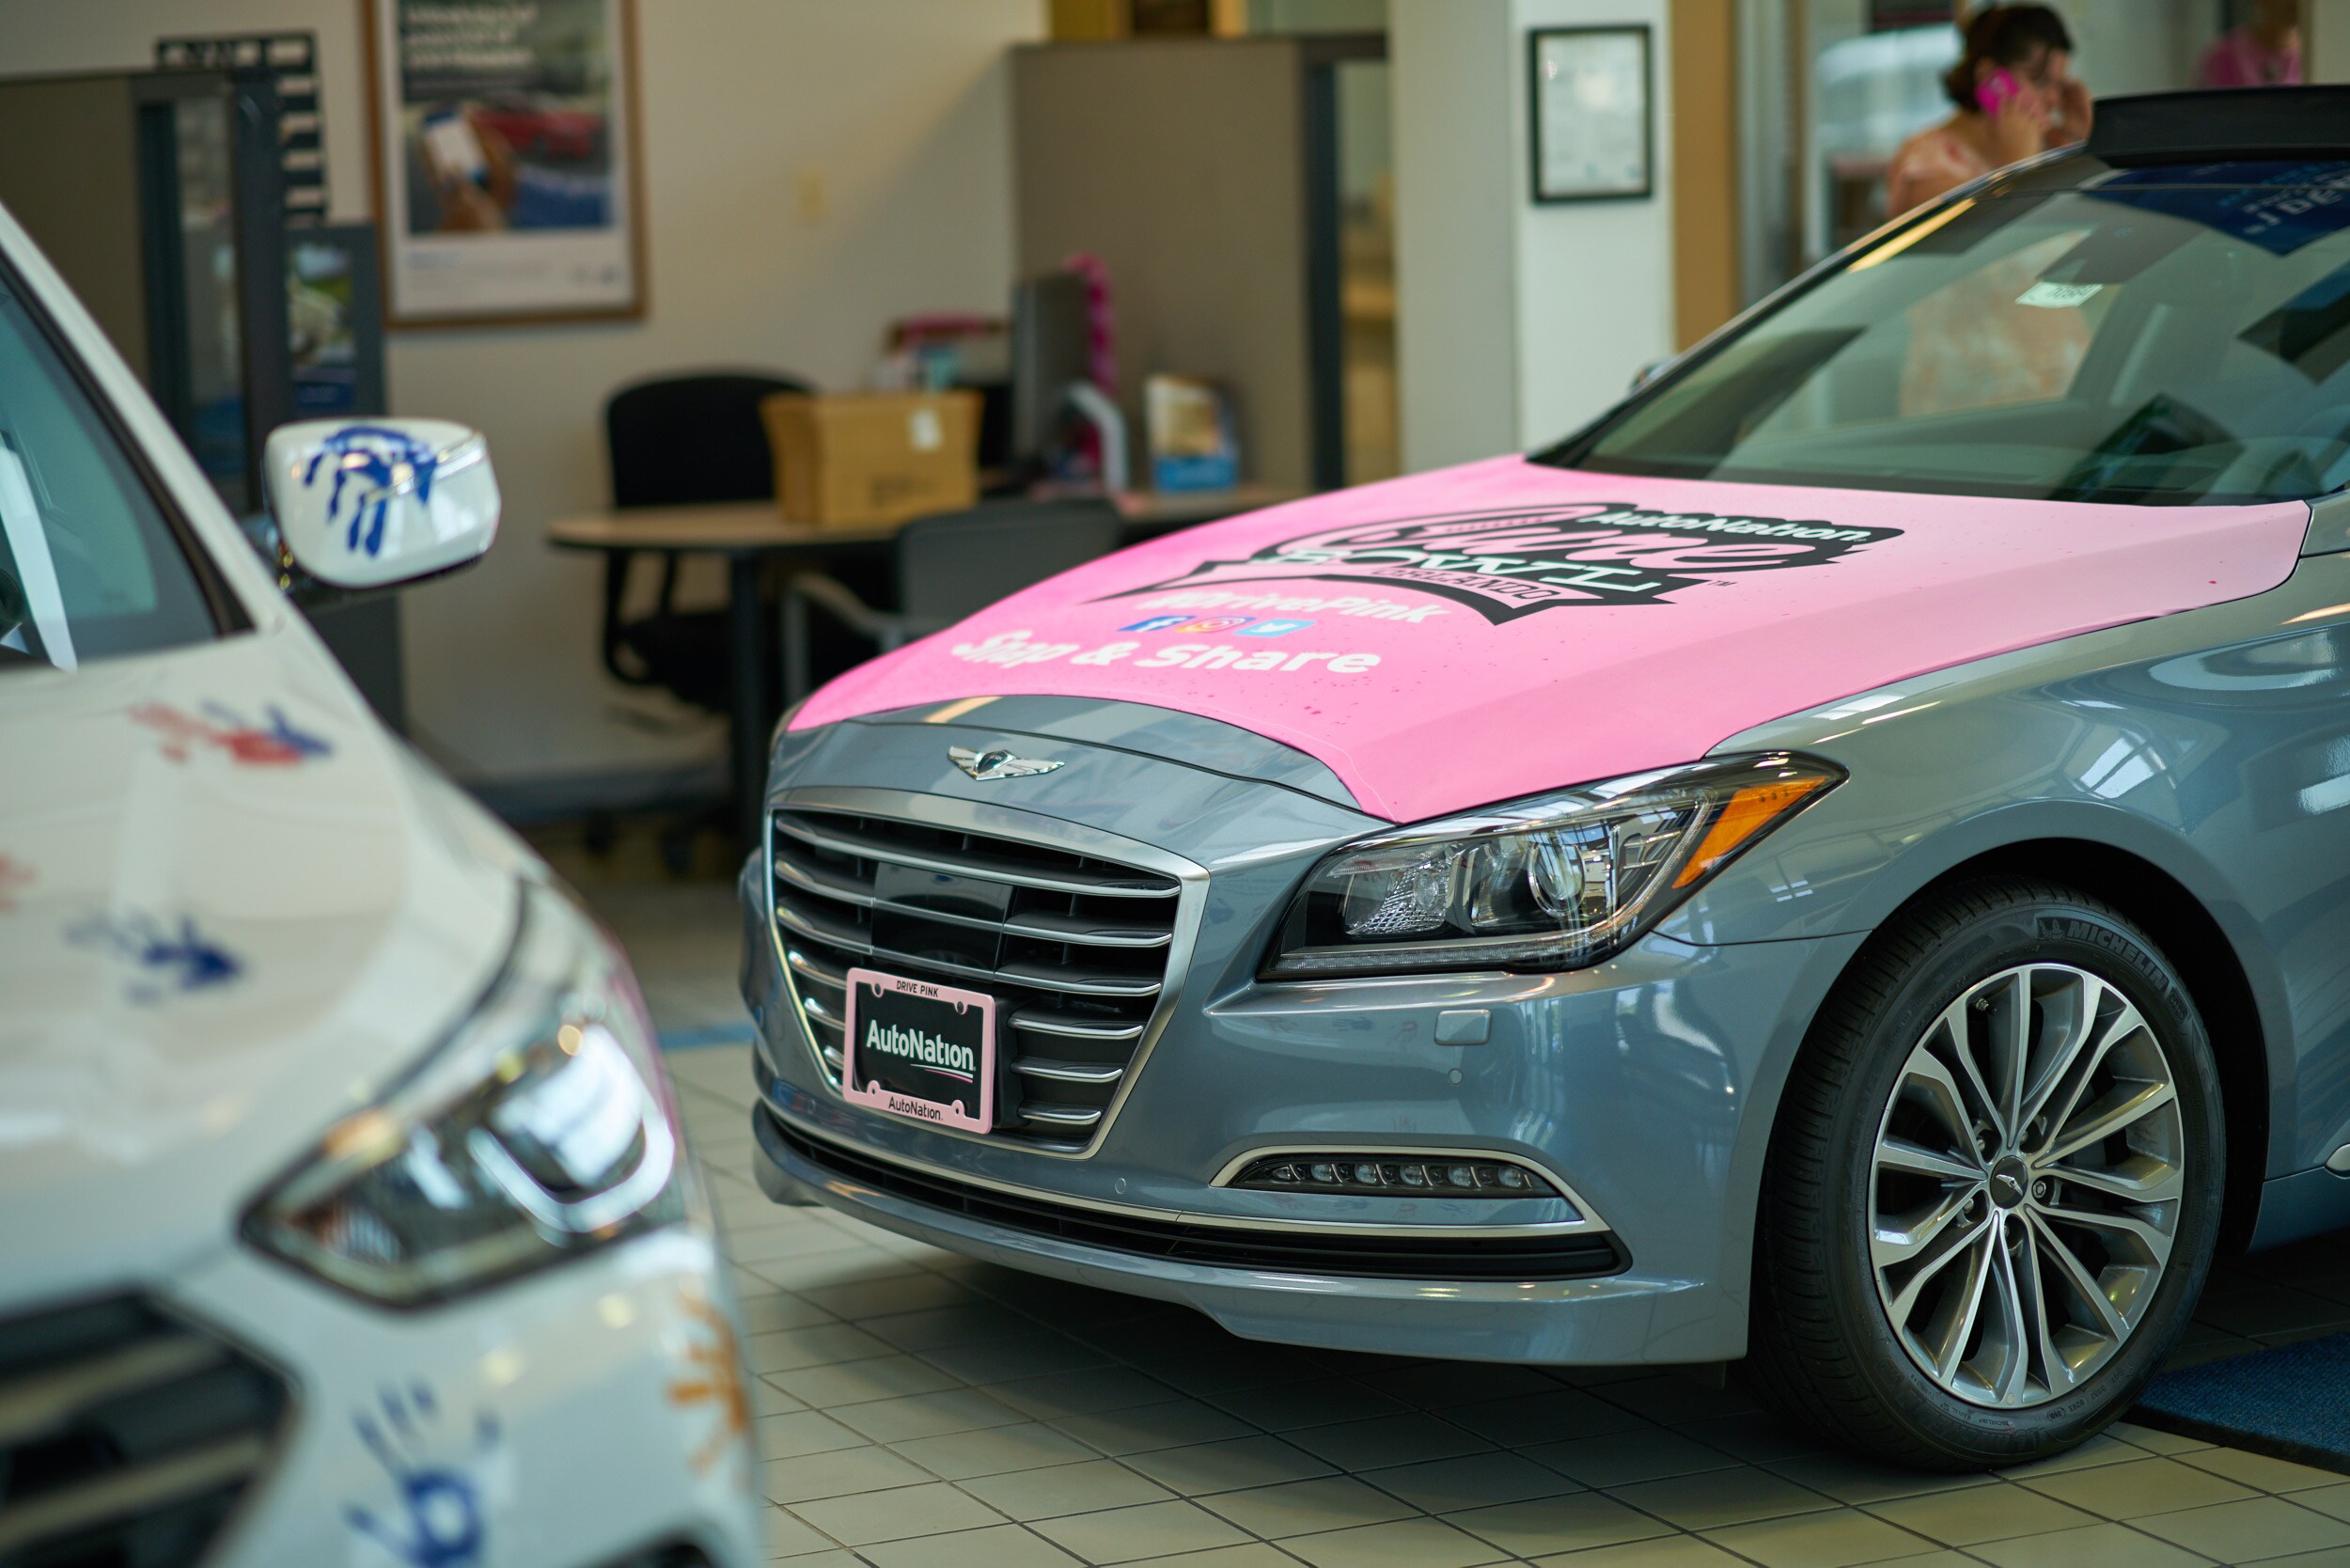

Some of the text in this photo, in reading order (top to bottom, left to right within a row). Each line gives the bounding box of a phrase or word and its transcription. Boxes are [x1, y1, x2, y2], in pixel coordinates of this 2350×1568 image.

[1277, 505, 1819, 570] Cure
[1576, 510, 1871, 541] AutoNation
[1246, 548, 1663, 592] BOWL
[1370, 568, 1562, 600] ORLANDO
[1134, 590, 1451, 624] #DrivePink
[1069, 640, 1141, 666] &
[1132, 641, 1382, 673] Share
[2067, 919, 2170, 991] MICHELIN
[896, 980, 939, 997] DRIVE PINK
[866, 1019, 974, 1072] AutoNation
[888, 1096, 941, 1121] AutoNation
